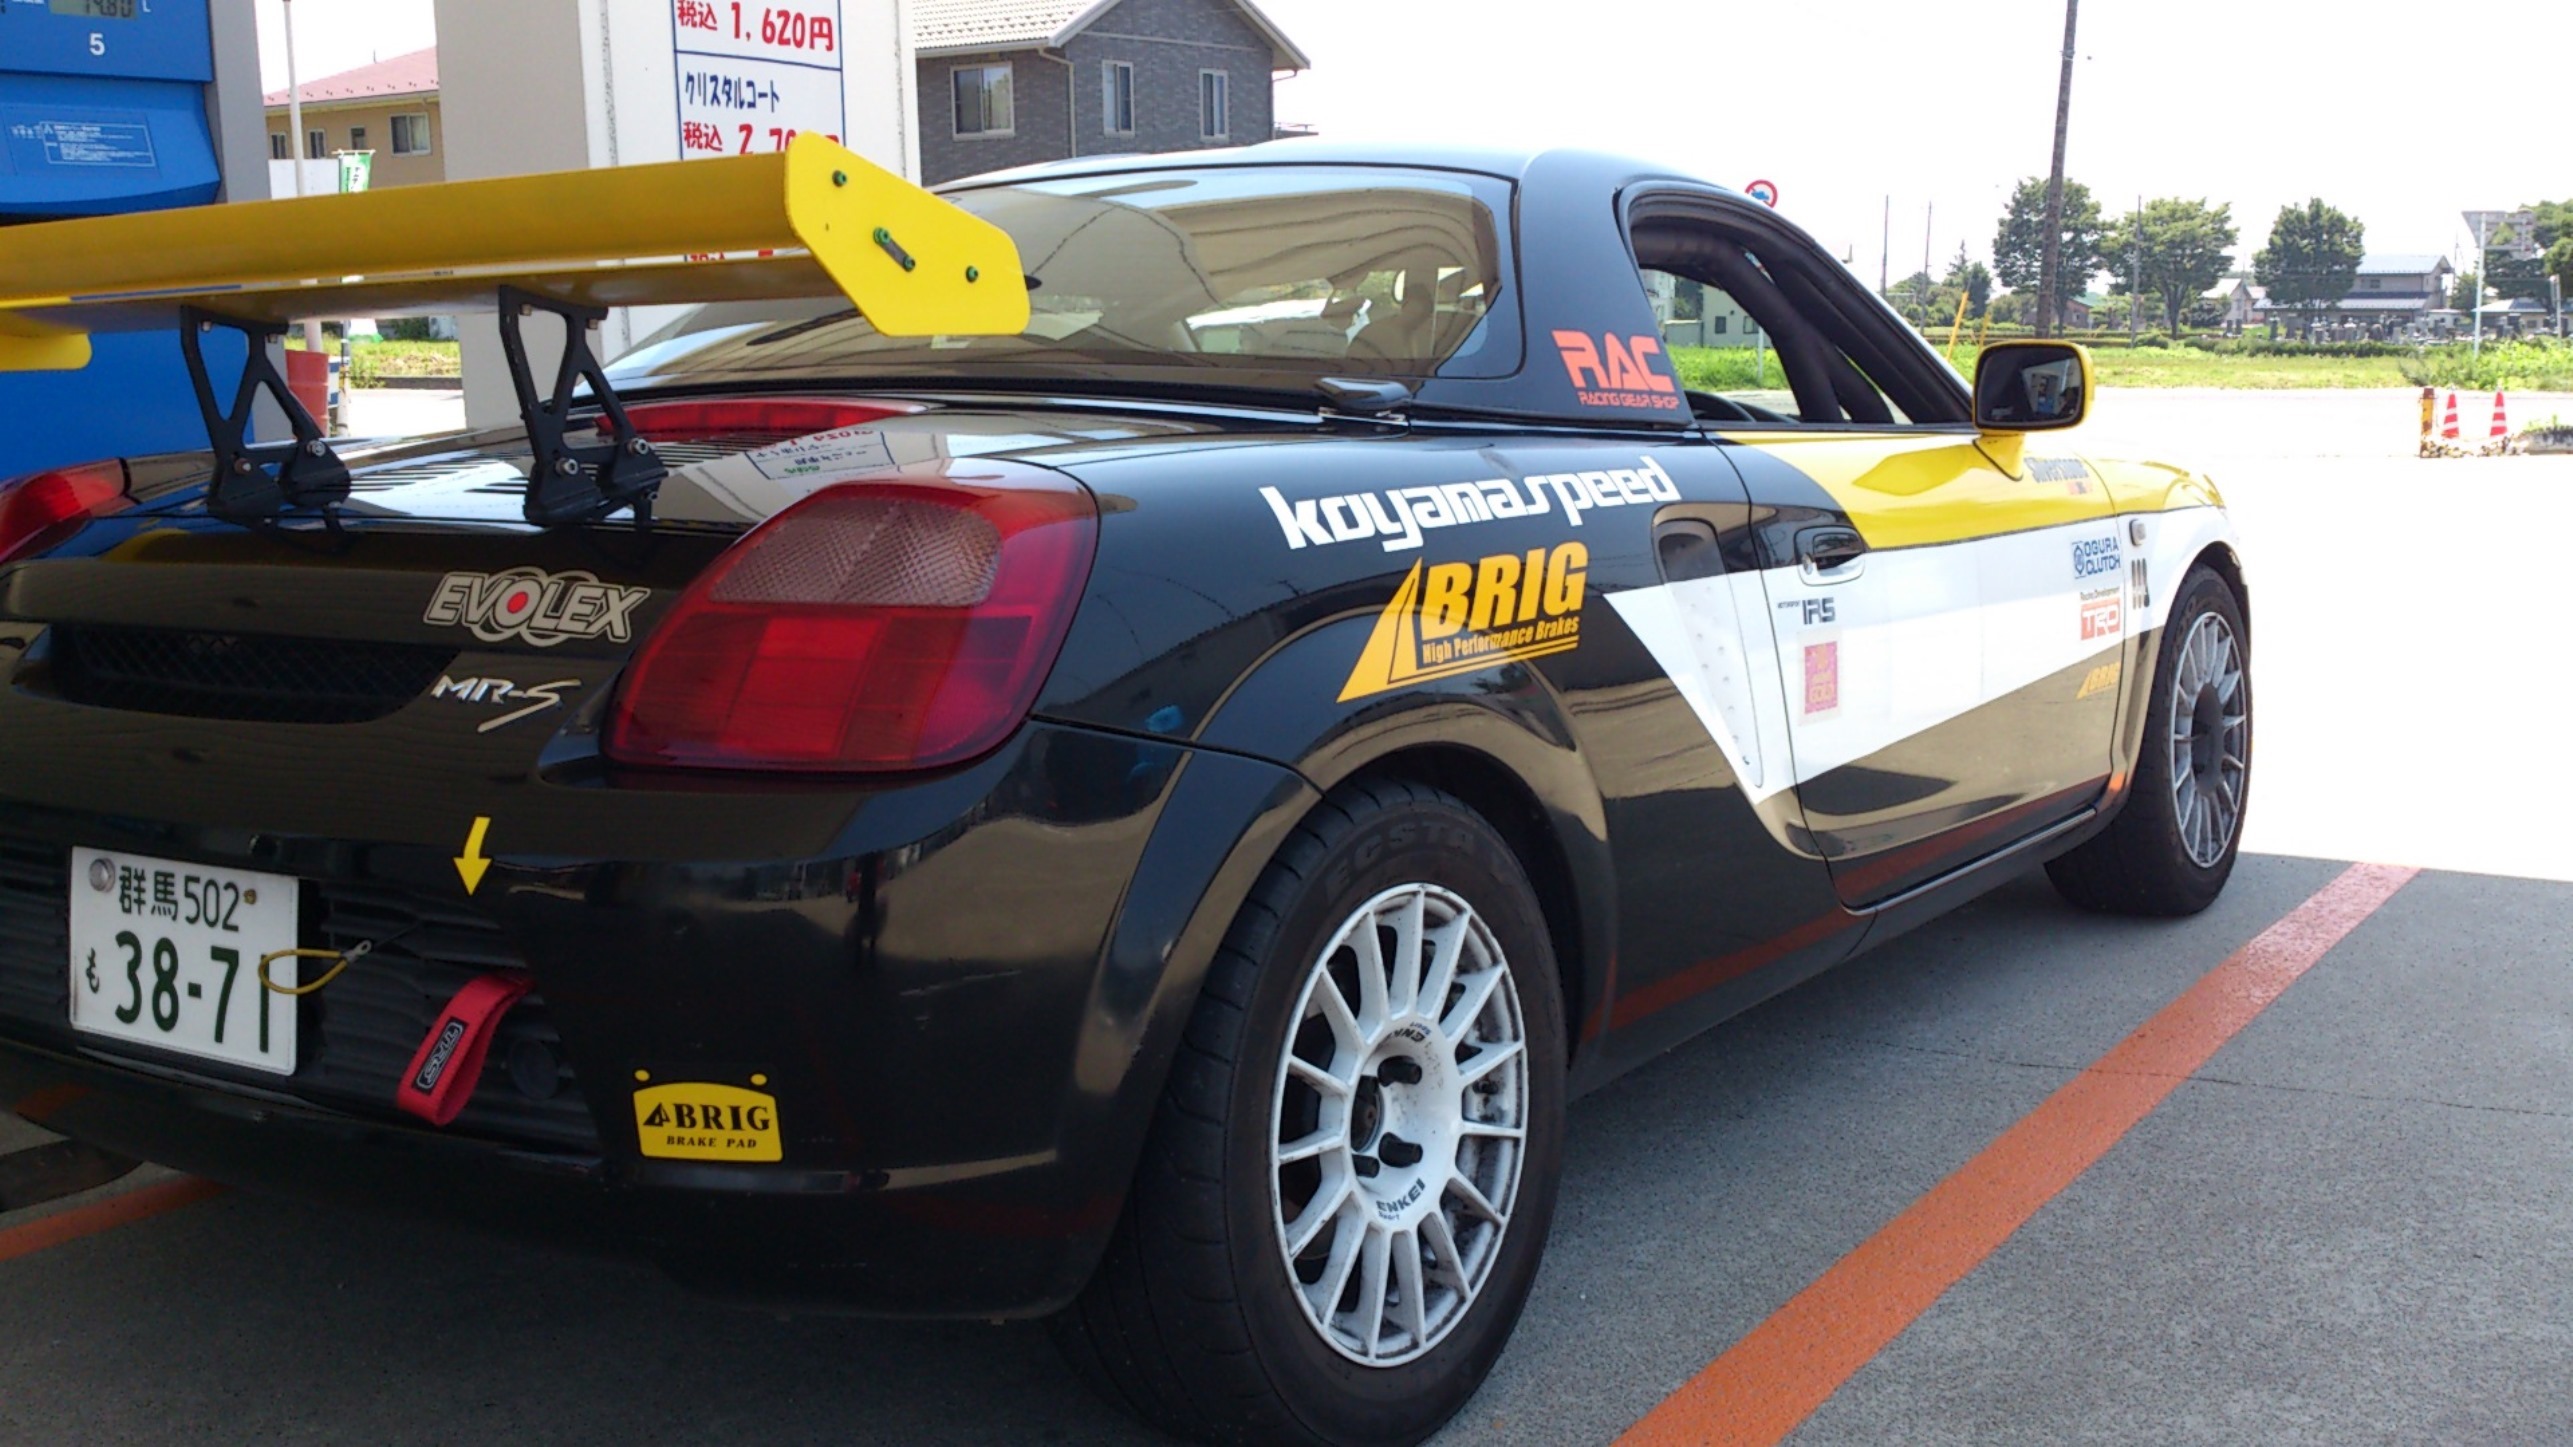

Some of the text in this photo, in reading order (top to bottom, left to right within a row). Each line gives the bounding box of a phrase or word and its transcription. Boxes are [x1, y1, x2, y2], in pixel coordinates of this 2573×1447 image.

[677, 0, 834, 51] 税込 1,620円
[89, 33, 106, 56] 5
[685, 71, 780, 113] クリスタルコート
[683, 121, 723, 152] 税込
[1551, 330, 1675, 393] RAC
[1577, 391, 1679, 410] RACING GEAR SHOP
[2084, 536, 2119, 557] OGURA
[2086, 554, 2121, 575] CLUTCH
[424, 570, 651, 644] EVOLEX
[1421, 541, 1588, 642] BRIG
[2082, 603, 2119, 637] TRD
[1422, 616, 1579, 664] High Performance Brakes
[430, 674, 583, 734] MR-S
[86, 930, 270, 1054] も 38-71
[673, 1103, 770, 1132] BRIG
[666, 1135, 757, 1148] BRAKE PAD
[1376, 1177, 1426, 1212] ENKEI
